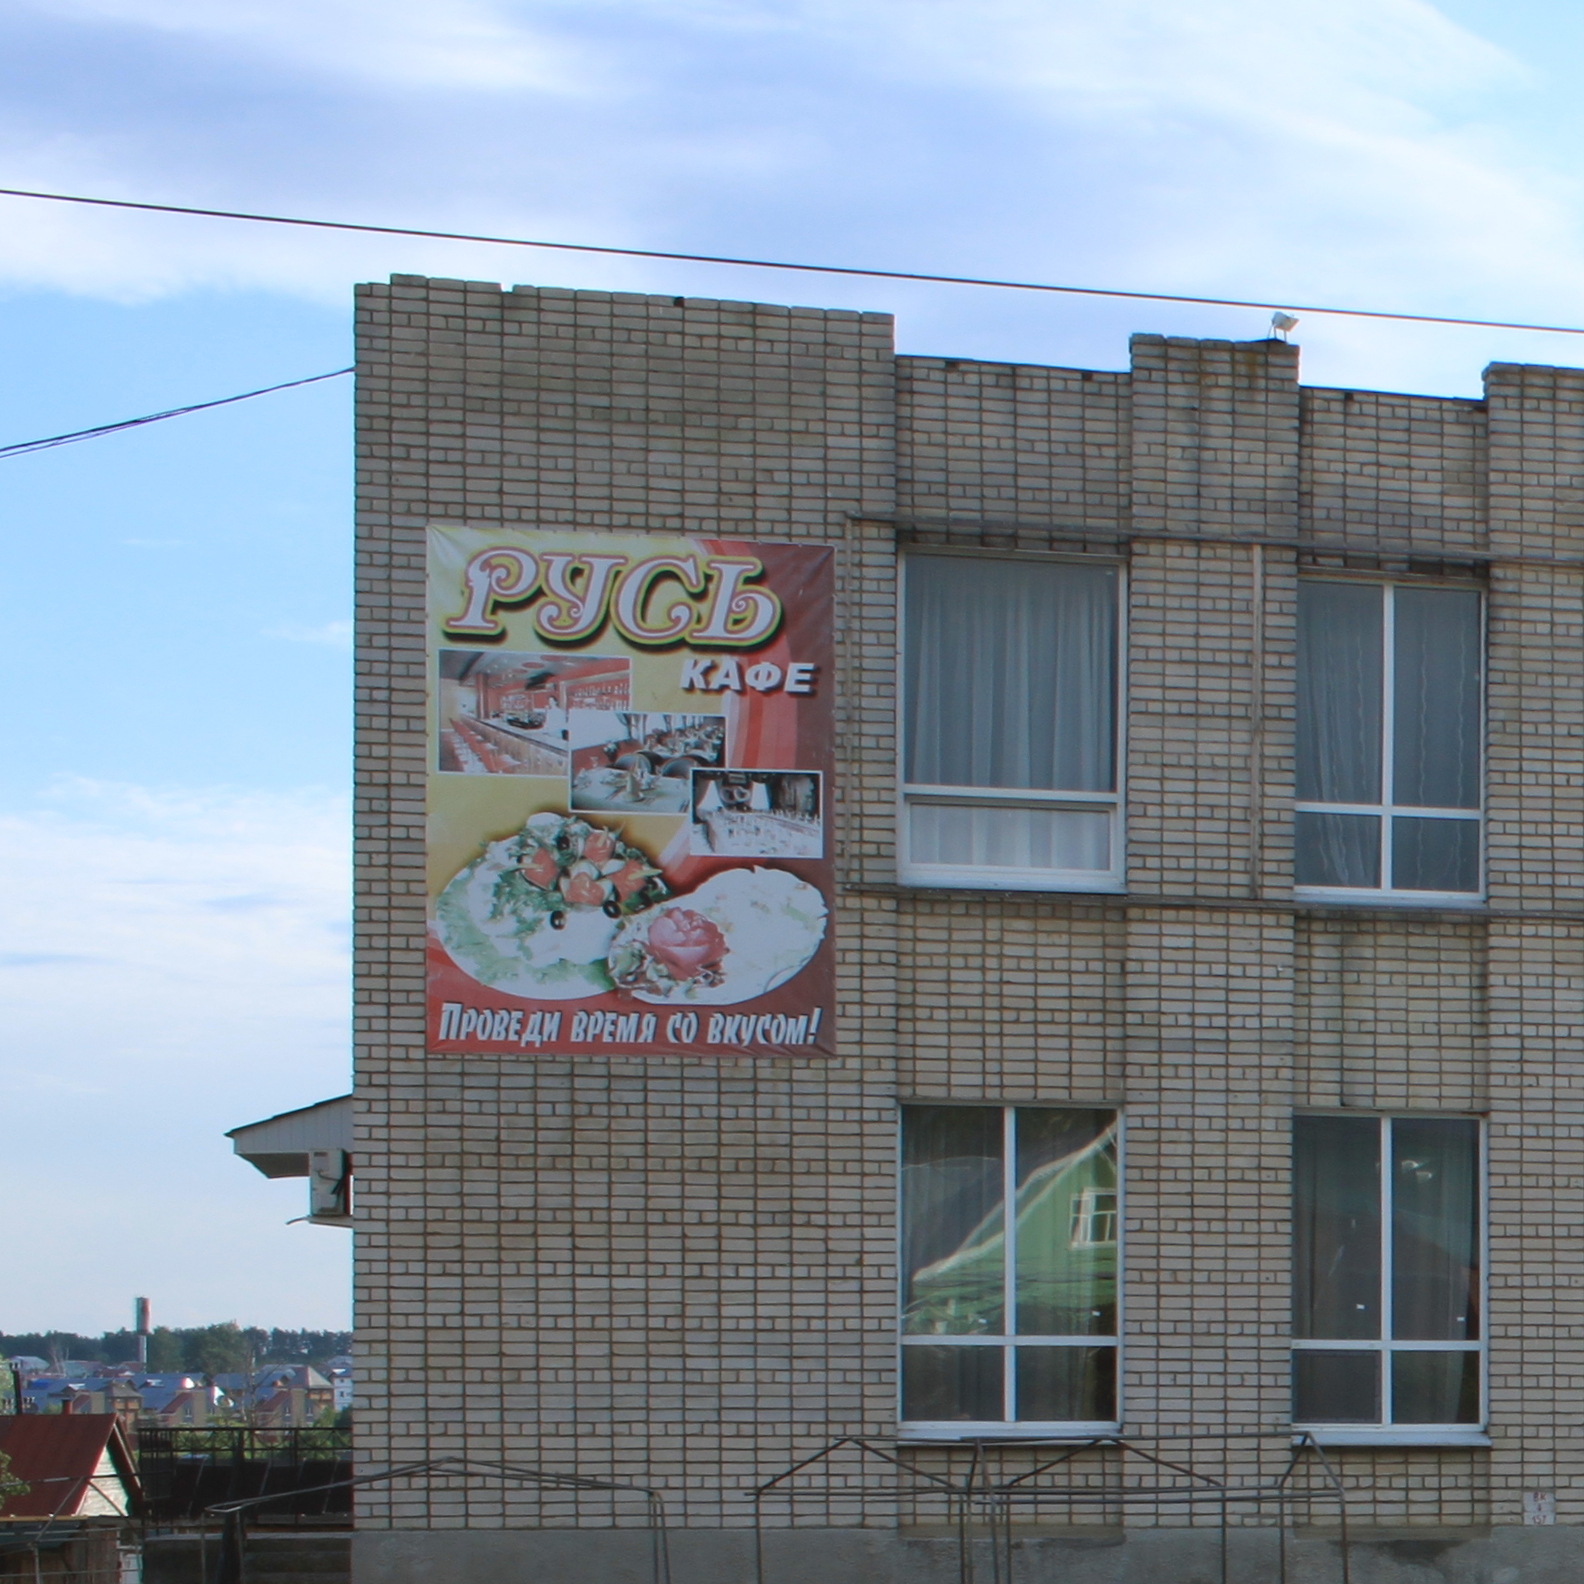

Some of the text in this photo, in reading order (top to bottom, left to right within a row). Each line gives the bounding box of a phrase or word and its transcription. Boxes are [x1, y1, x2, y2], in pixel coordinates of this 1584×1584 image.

[445, 546, 782, 644] РУСЬ
[680, 657, 815, 694] КАФЕ
[570, 1009, 658, 1043] ВРЕМЯ
[666, 1010, 699, 1044] СО
[707, 1007, 822, 1046] ВКУСОМ!
